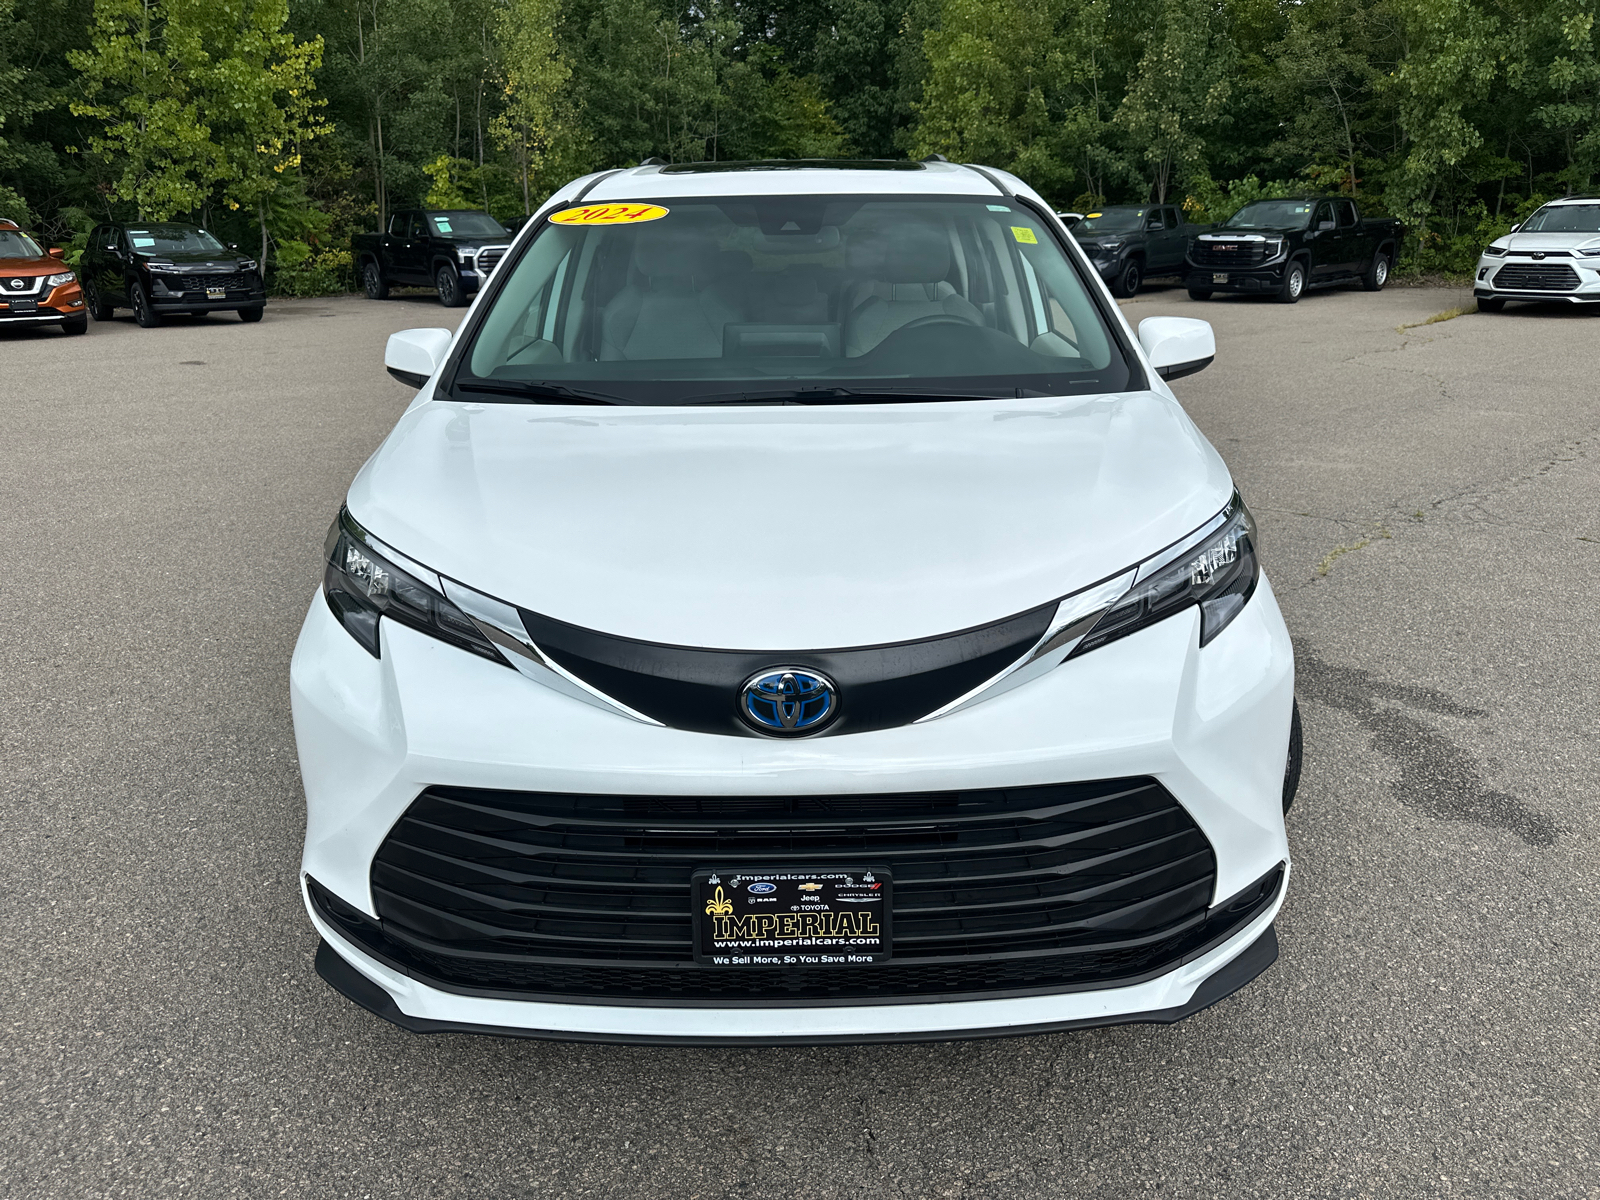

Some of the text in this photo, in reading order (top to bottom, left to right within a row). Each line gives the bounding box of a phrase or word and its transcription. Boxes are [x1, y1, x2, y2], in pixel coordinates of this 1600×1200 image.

[562, 207, 653, 222] 2024
[736, 873, 847, 881] Imperialcars.com
[753, 884, 771, 892] Ford
[800, 894, 820, 903] Jeep
[713, 912, 879, 940] IMPERIAL
[713, 936, 880, 948] www.imperialcars.com
[713, 954, 873, 965] We Sell More, So You Save More
